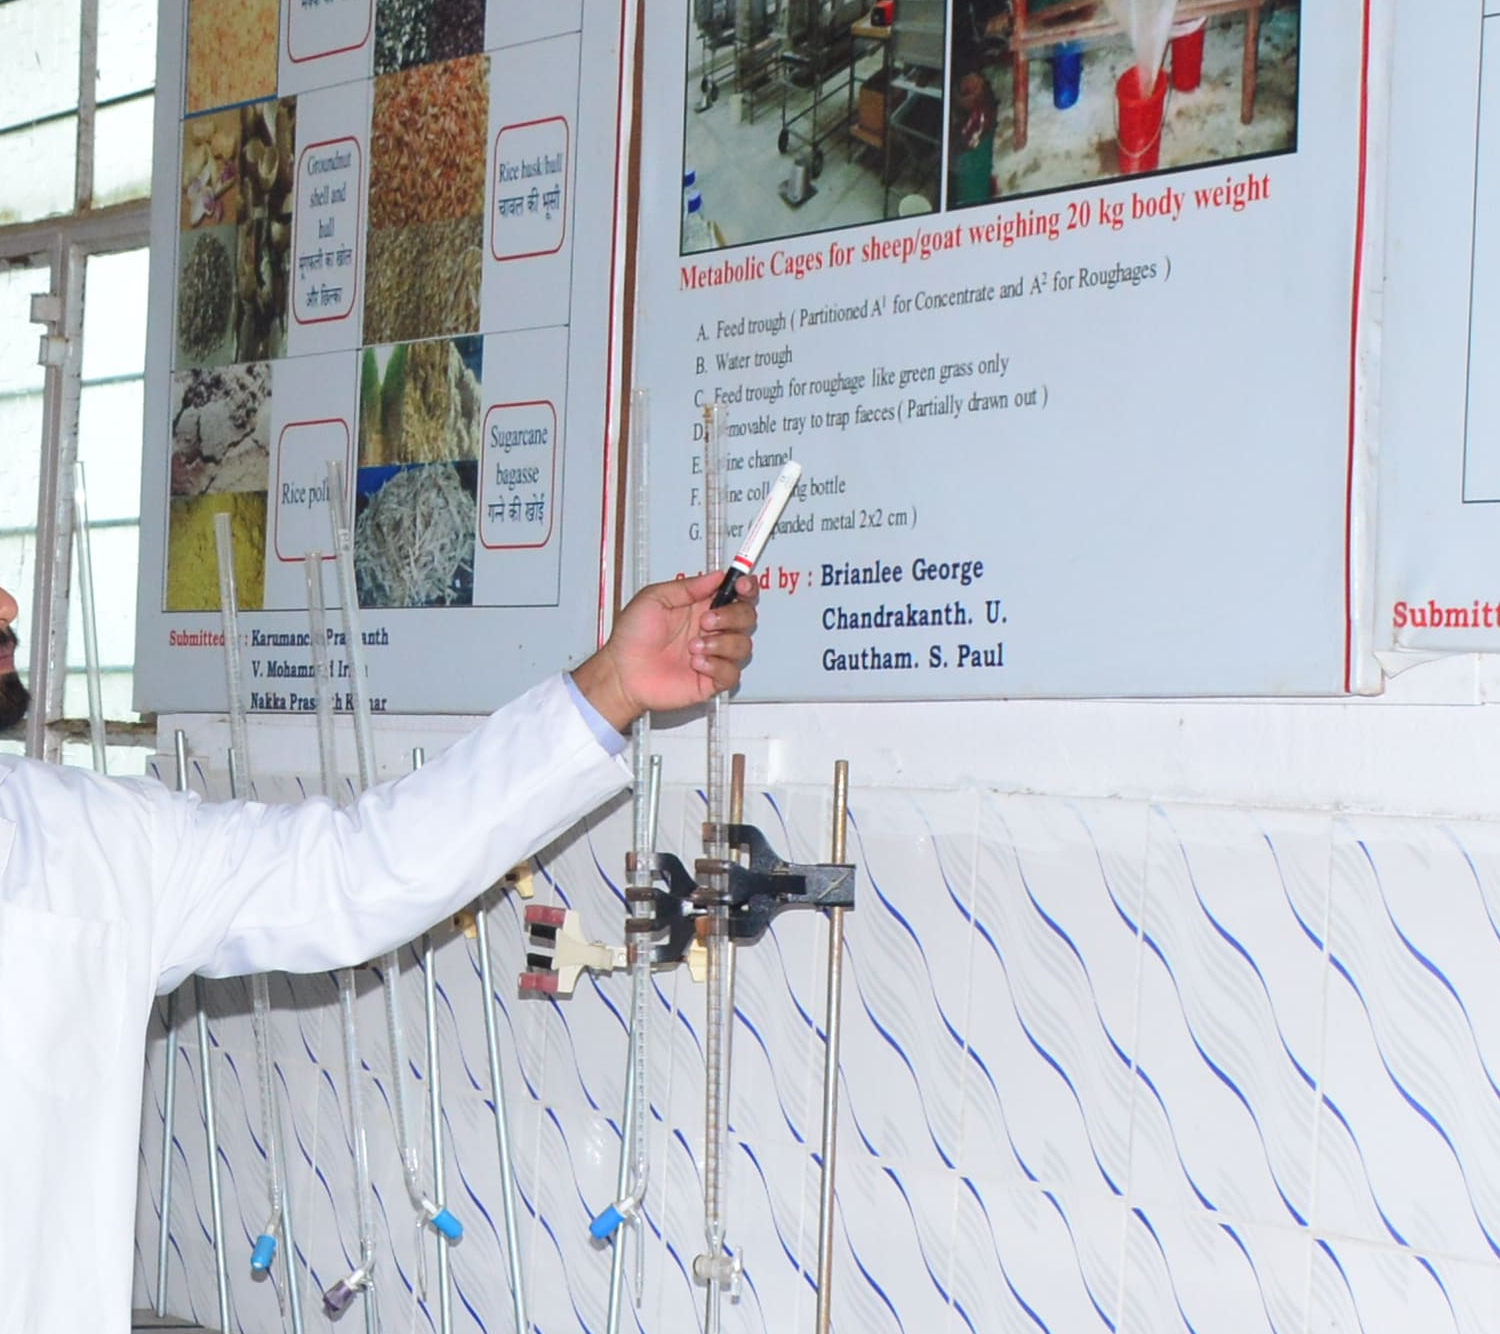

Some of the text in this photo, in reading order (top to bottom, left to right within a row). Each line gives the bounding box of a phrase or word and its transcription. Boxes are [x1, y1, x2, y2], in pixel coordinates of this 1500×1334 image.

[498, 161, 519, 183] Rice
[331, 181, 347, 204] and
[679, 172, 1271, 290] Metabolic Cages for sheep/goat weighing 20 kg body weight
[696, 324, 710, 342] A.
[716, 317, 745, 340] Feed
[748, 312, 787, 337] trough
[799, 302, 868, 327] Partitioned
[892, 295, 913, 314] for
[914, 282, 994, 311] Concentrate
[1000, 277, 1023, 299] and
[1053, 270, 1075, 292] for
[1078, 262, 1157, 290] Roughages
[696, 345, 793, 374] B. Water trough
[714, 385, 743, 404] Feed
[745, 380, 784, 404] trough
[788, 378, 807, 397] for
[809, 371, 865, 397] roughage
[872, 367, 895, 387] like
[899, 366, 935, 389] green
[939, 360, 973, 384] grass
[978, 351, 1009, 377] only
[783, 416, 806, 435] tray
[811, 413, 823, 428] to
[826, 412, 850, 430] trap
[855, 405, 895, 424] faeces
[907, 394, 963, 418] Partially
[967, 391, 1008, 412] drawn
[1014, 389, 1037, 407] out
[490, 425, 548, 453] Sugarcane
[749, 447, 793, 469] channel
[495, 462, 540, 491] bagasse
[810, 475, 846, 496] bottle
[281, 481, 305, 504] Rice
[821, 511, 855, 531] metal
[859, 508, 882, 529] 2x2
[887, 512, 908, 527] cm
[778, 566, 801, 594] by
[820, 559, 903, 586] Brianlee
[912, 558, 984, 586] George
[822, 600, 1007, 630] Chandrakanth. U.
[822, 643, 1004, 671] Gautham. S. Paul
[251, 692, 286, 711] Nakka
